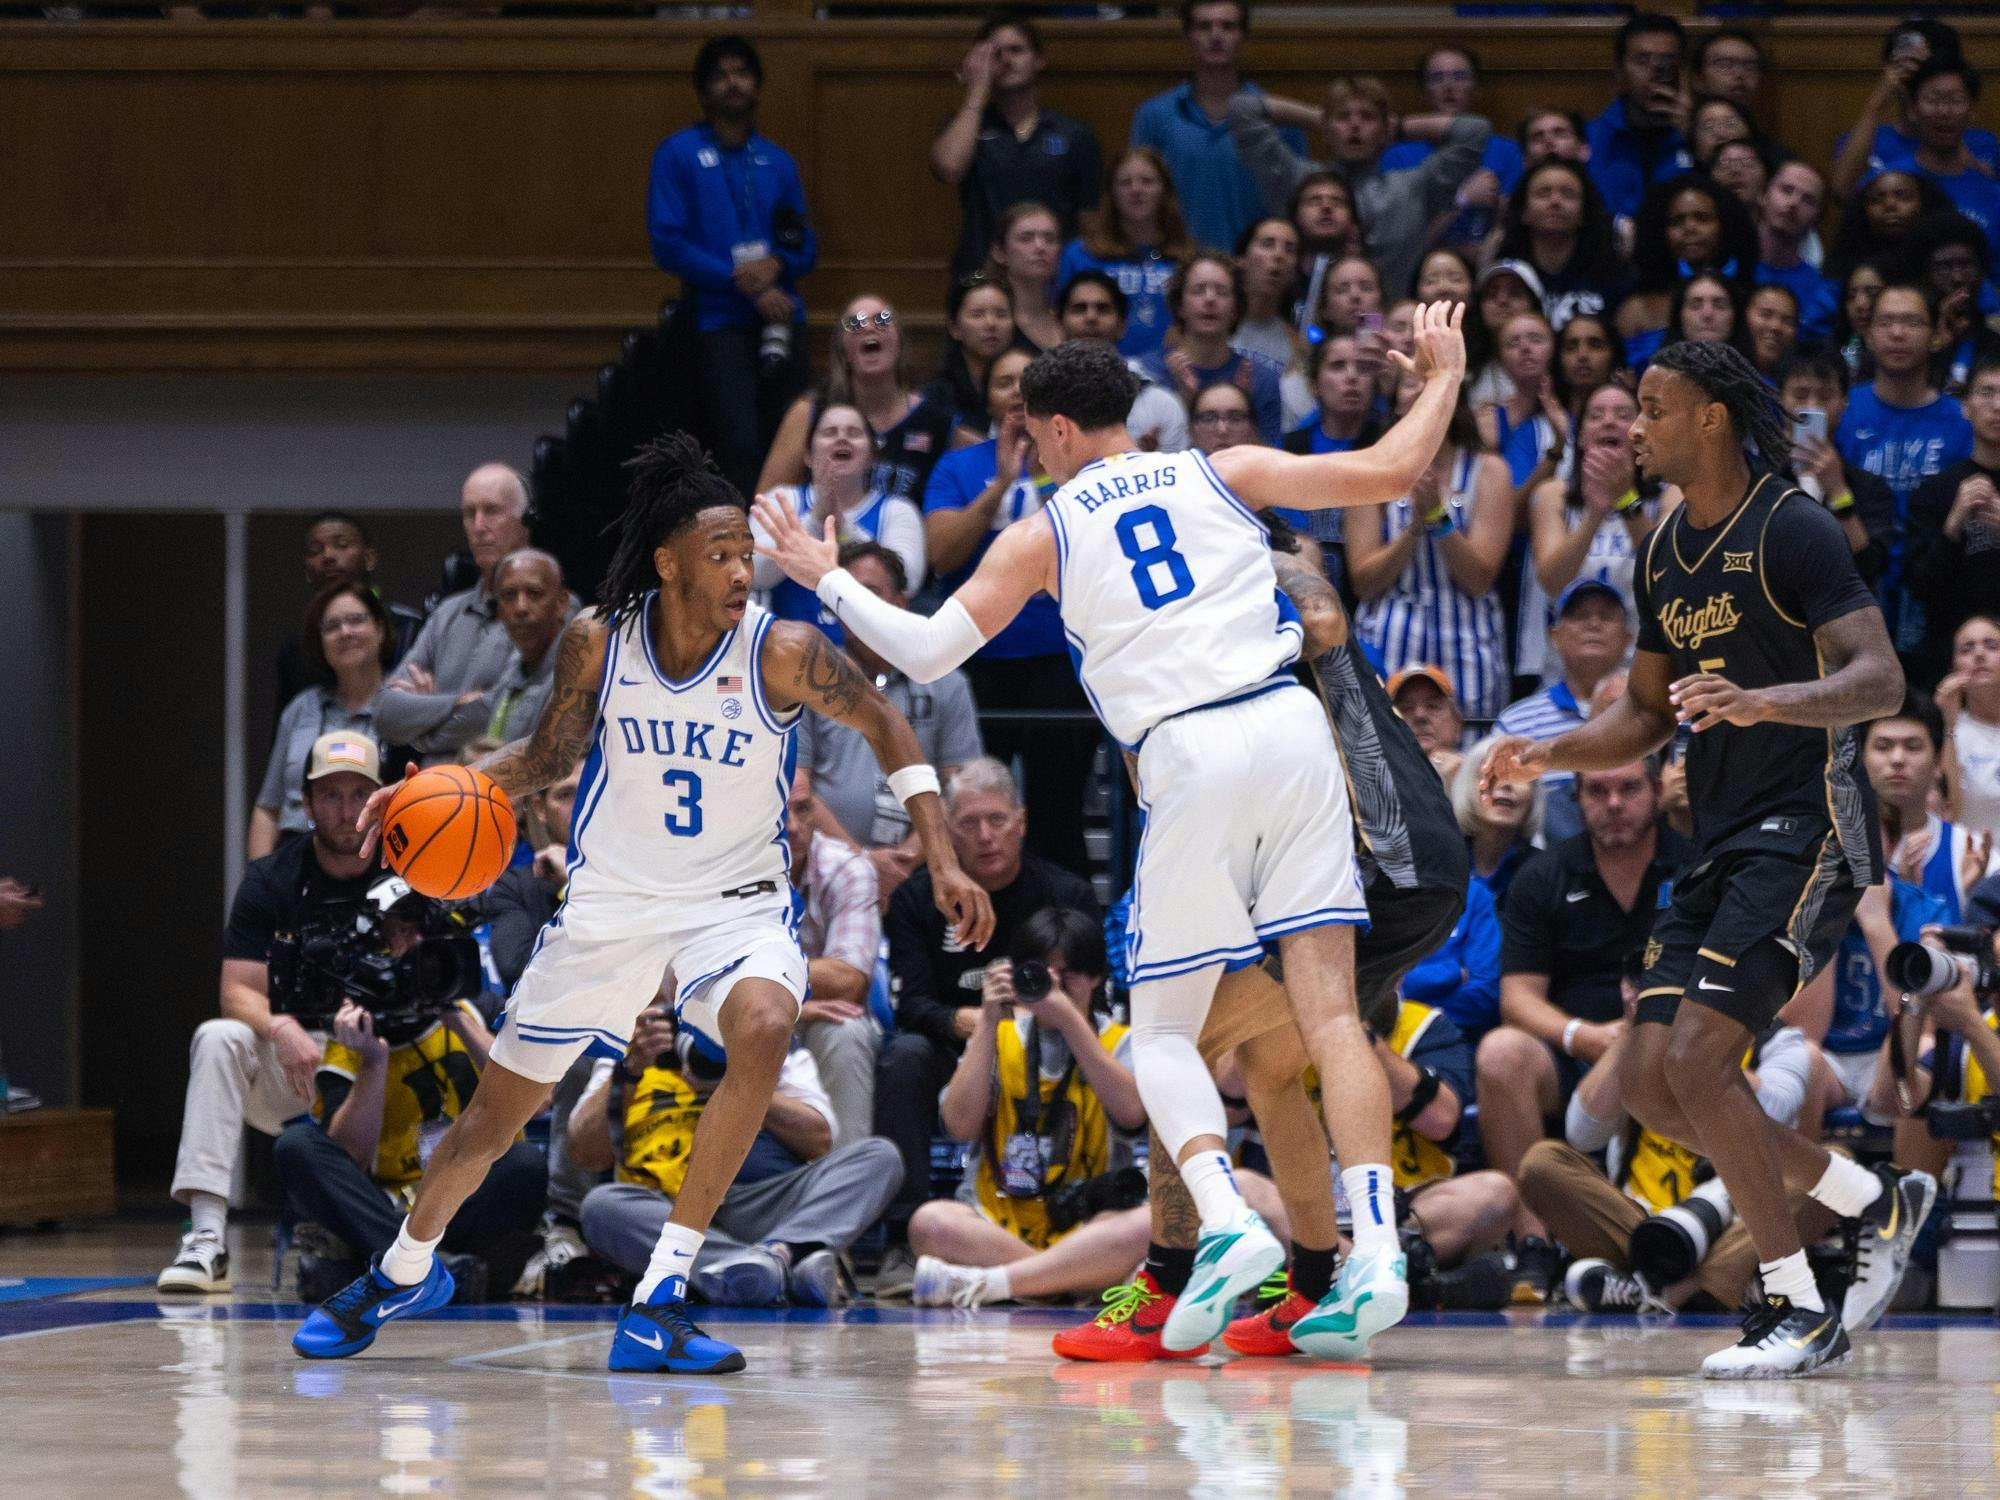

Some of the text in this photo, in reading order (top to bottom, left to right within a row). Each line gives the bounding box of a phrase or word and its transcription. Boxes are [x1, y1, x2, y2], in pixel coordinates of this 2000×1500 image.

[1074, 466, 1176, 514] HARRIS
[1114, 504, 1196, 611] 8
[1657, 592, 1742, 649] Knights
[617, 717, 753, 768] DUKE
[662, 769, 703, 837] 3
